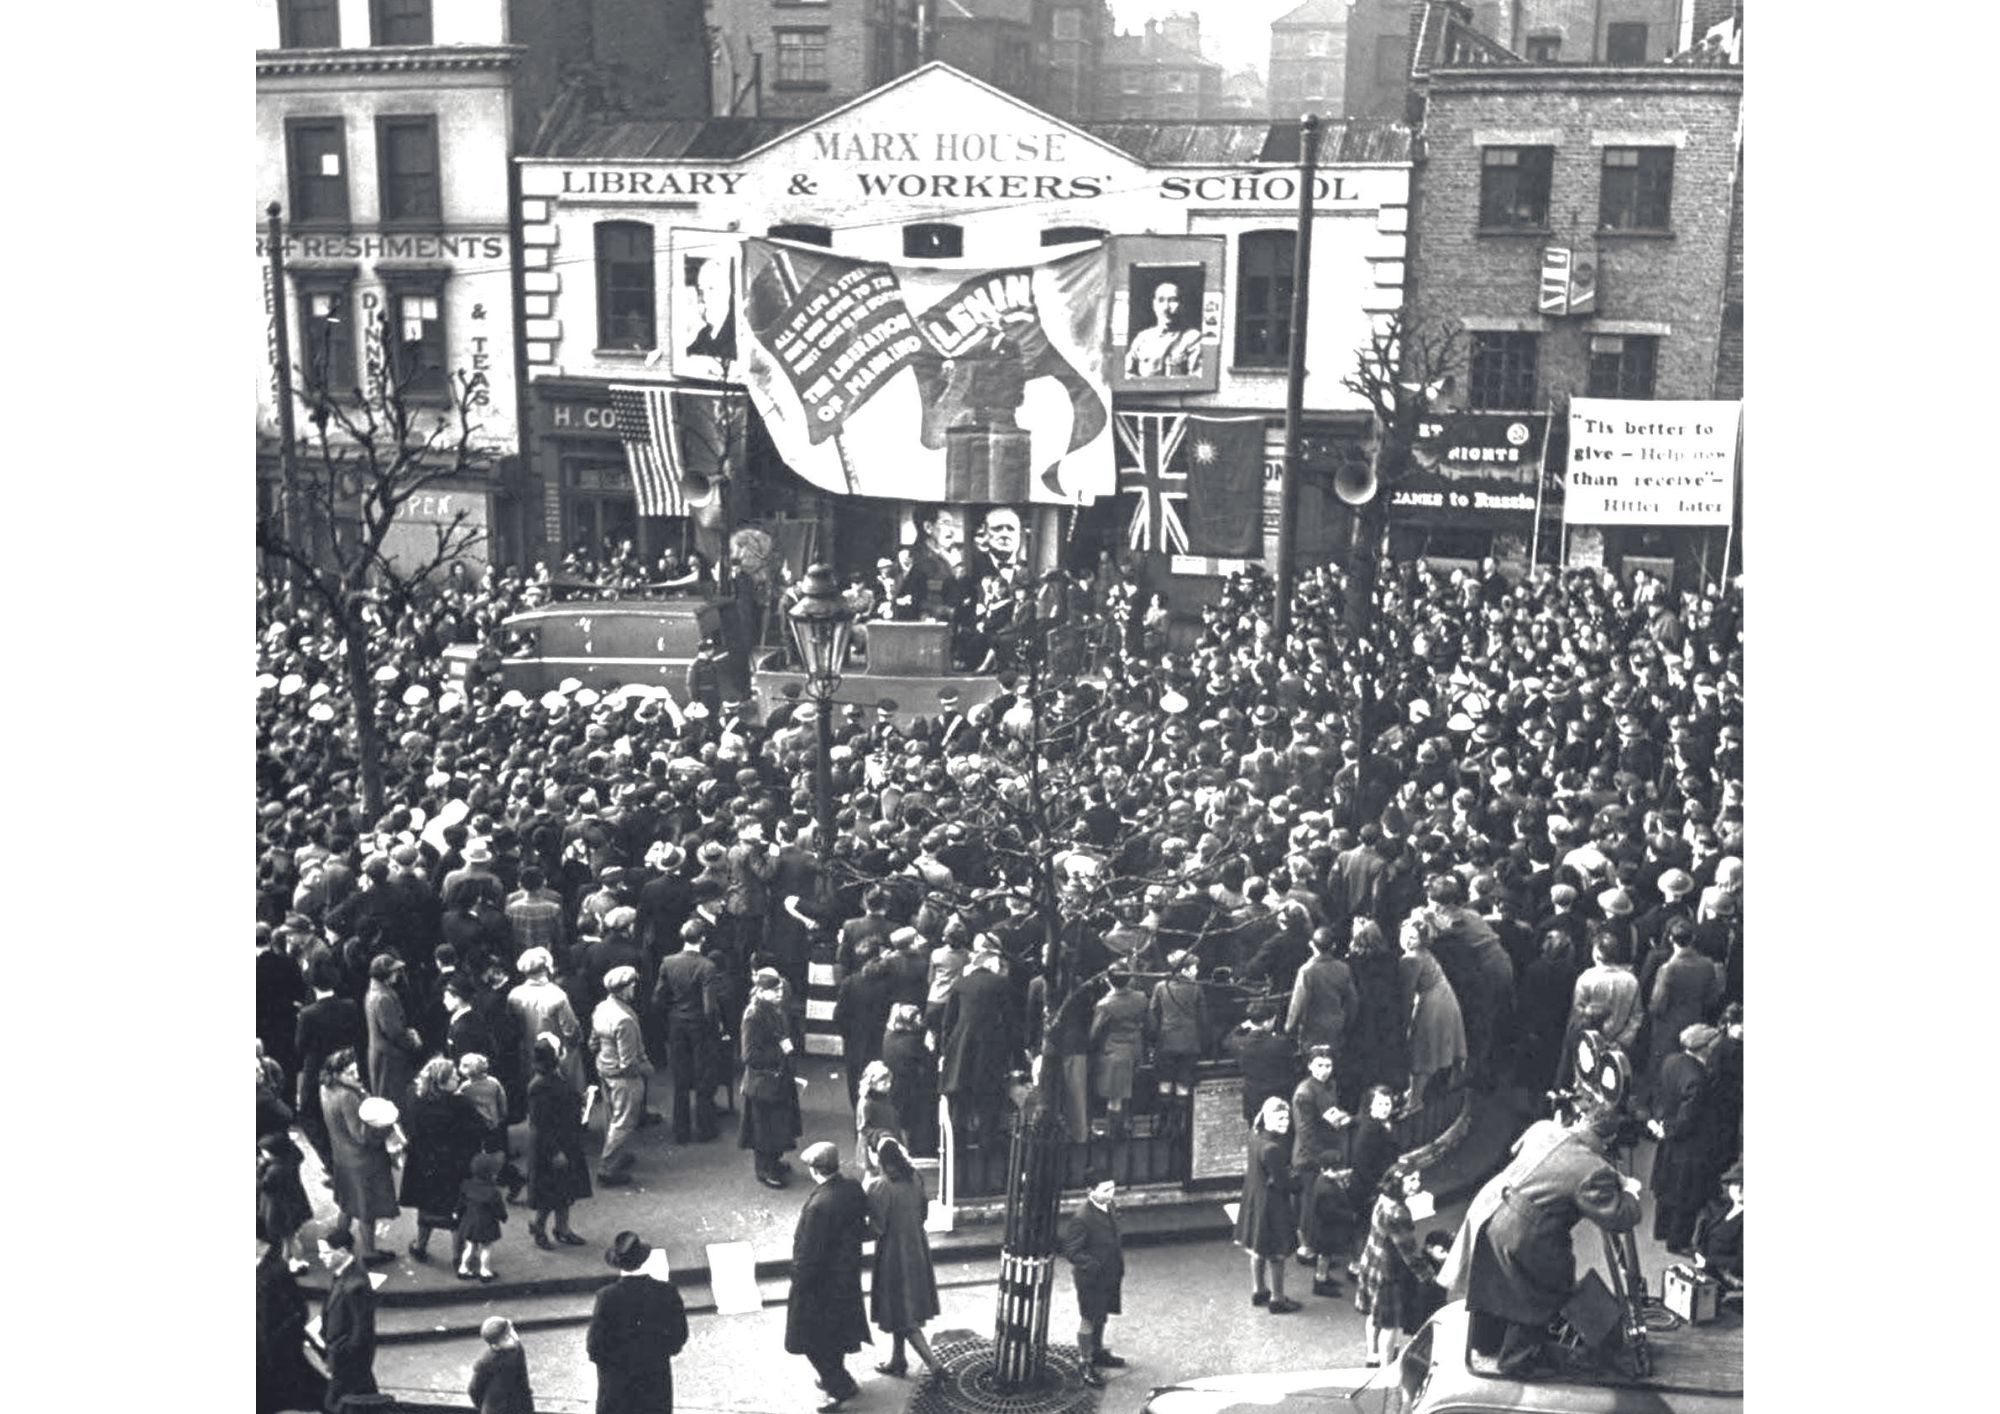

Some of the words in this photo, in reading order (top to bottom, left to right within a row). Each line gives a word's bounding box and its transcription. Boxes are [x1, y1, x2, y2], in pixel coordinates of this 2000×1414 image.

[813, 132, 920, 162] MARX
[935, 132, 1067, 162] HOUSE
[561, 170, 747, 194] LIBRARY
[786, 173, 818, 196] &
[857, 173, 1113, 200] WORKERS'
[1159, 176, 1359, 201] SCHOOL
[255, 236, 504, 259] RFRESHMENTS
[471, 303, 488, 320] &
[928, 274, 1031, 351] LENIN
[828, 312, 911, 381] LIBERATION
[472, 337, 490, 406] TEAS
[817, 394, 844, 422] OF
[844, 335, 922, 396] MANKIND
[1625, 421, 1687, 435] better
[1696, 423, 1713, 435] to
[1574, 446, 1614, 462] give
[1573, 472, 1619, 486] than
[399, 494, 452, 516] PEN
[1449, 492, 1470, 508] to
[1474, 492, 1536, 509] Russia
[1679, 500, 1722, 513] later
